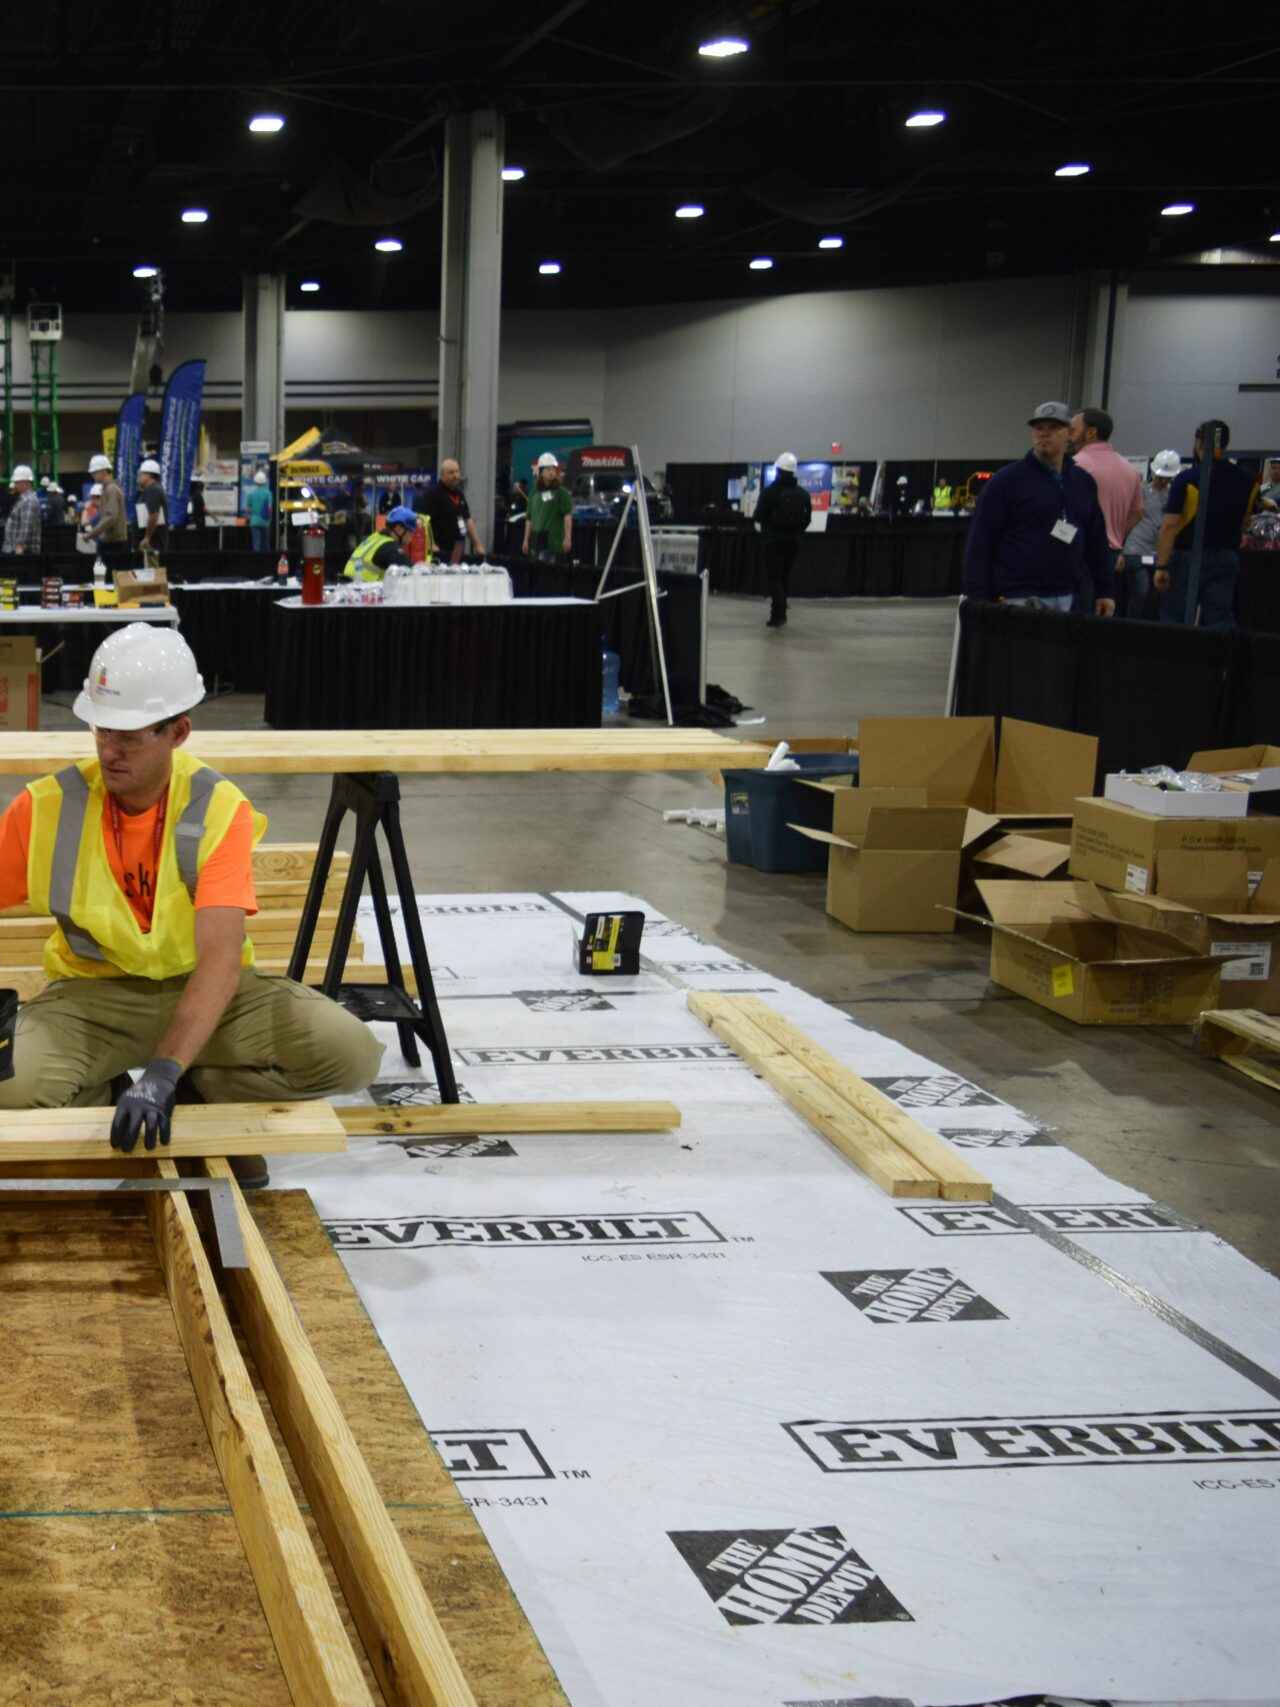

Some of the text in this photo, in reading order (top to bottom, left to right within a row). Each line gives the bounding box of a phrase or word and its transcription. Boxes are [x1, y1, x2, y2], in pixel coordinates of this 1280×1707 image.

[327, 475, 348, 483] CAP
[376, 474, 431, 483] WHITE CAP
[328, 1218, 756, 1246] EVERBILT TM
[851, 1274, 896, 1296] THE
[864, 1268, 955, 1323] HOME
[920, 1285, 978, 1322] DEPOT
[558, 1470, 592, 1479] TM
[1193, 1478, 1277, 1491] ICC-ES
[463, 1496, 549, 1508] SR-3431
[705, 1538, 768, 1576] THE
[717, 1527, 854, 1624] HOME
[794, 1560, 878, 1625] DEPOT
